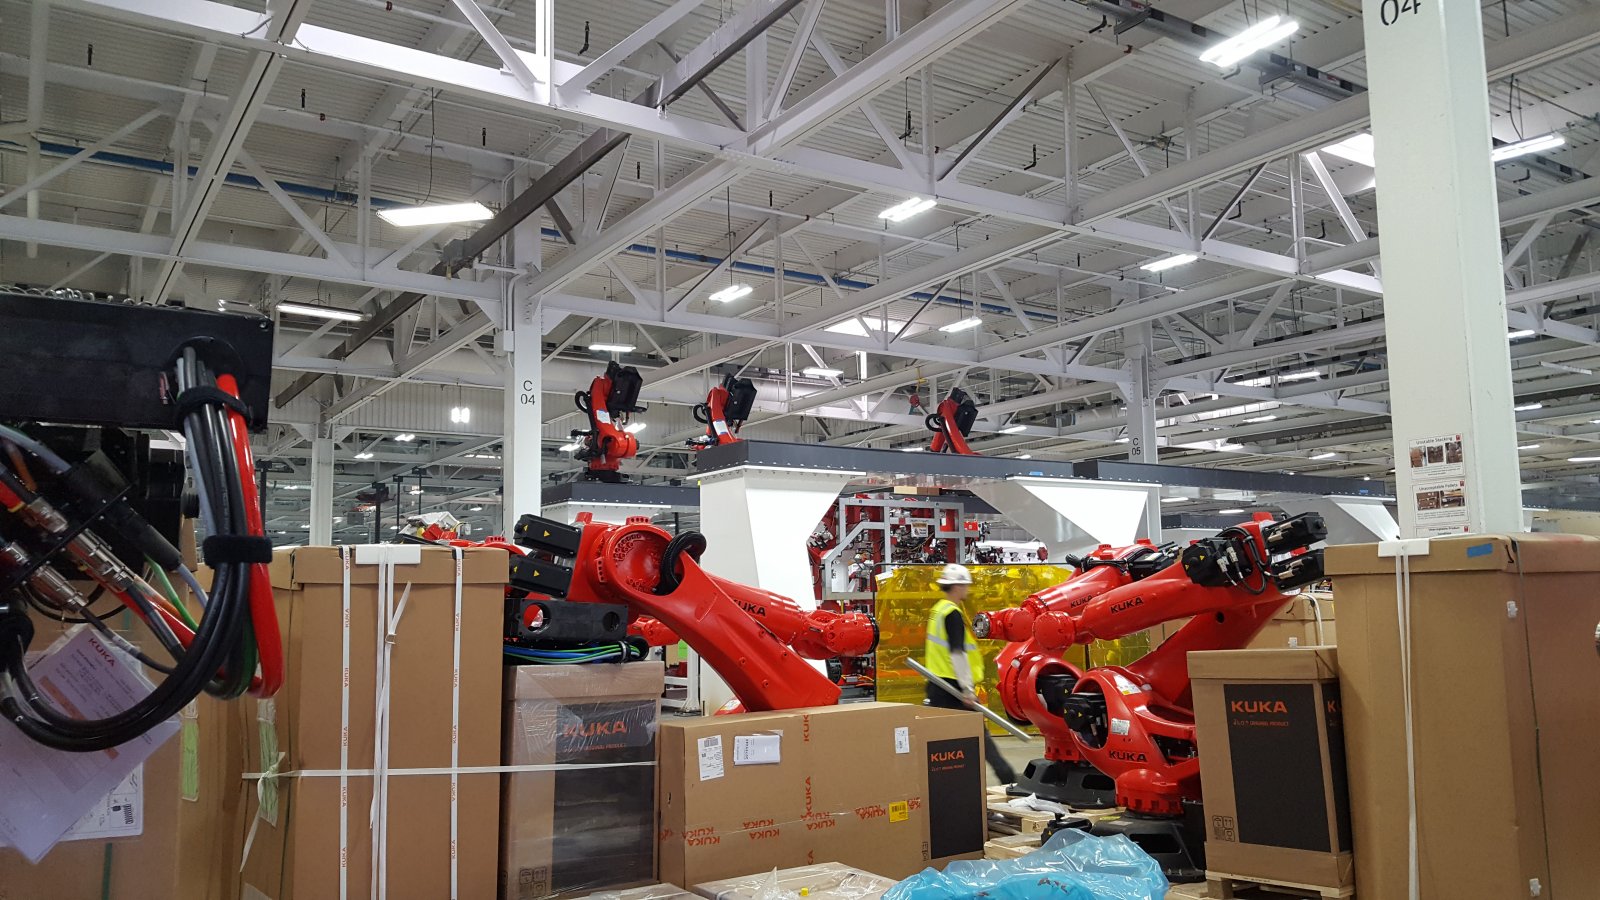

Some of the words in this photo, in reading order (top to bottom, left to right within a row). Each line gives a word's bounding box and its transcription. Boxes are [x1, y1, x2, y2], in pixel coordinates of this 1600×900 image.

[1380, 0, 1421, 26] 04
[523, 380, 533, 392] C
[520, 393, 535, 405] 04
[1132, 437, 1139, 446] C
[1131, 446, 1141, 456] 05
[1071, 595, 1094, 608] KUKA
[1110, 597, 1143, 614] KUKA
[734, 599, 766, 617] UKA
[88, 638, 115, 667] KUKA
[1231, 701, 1288, 713] KUKA
[563, 720, 627, 737] KUKA
[931, 750, 965, 762] KUKA
[1109, 750, 1147, 762] KUKA
[742, 818, 774, 830] KUKA
[806, 819, 835, 831] KUKA
[749, 829, 780, 840] KUKA
[687, 836, 720, 847] KUKA
